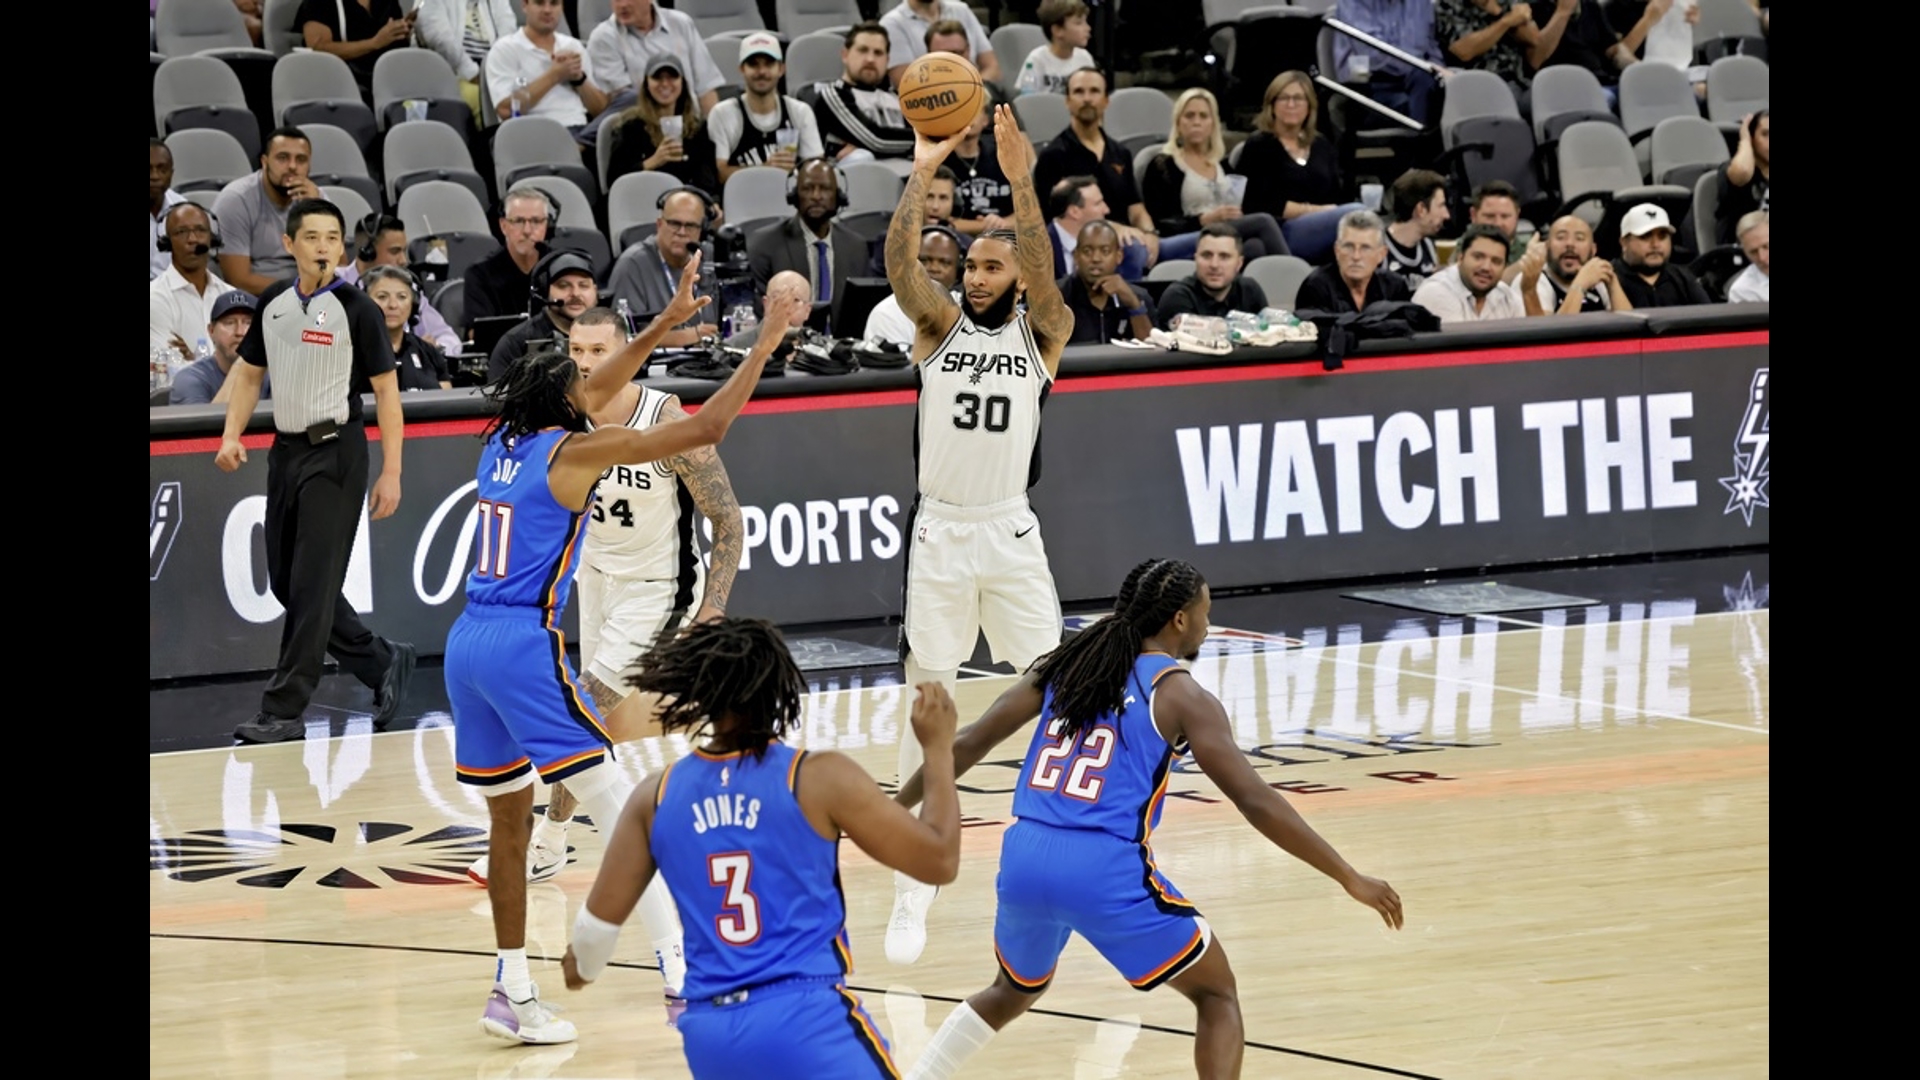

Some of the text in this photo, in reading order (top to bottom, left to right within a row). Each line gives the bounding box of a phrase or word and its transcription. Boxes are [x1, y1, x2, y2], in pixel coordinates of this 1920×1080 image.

[903, 90, 959, 111] Wilson
[941, 352, 1027, 385] SPURS
[953, 392, 1011, 433] 30
[492, 457, 522, 485] JOE
[1176, 392, 1697, 545] WATCH THE
[591, 496, 634, 528] 54
[478, 497, 514, 579] 11
[1029, 717, 1117, 803] 22
[691, 793, 761, 834] JONES
[707, 850, 762, 947] 3
